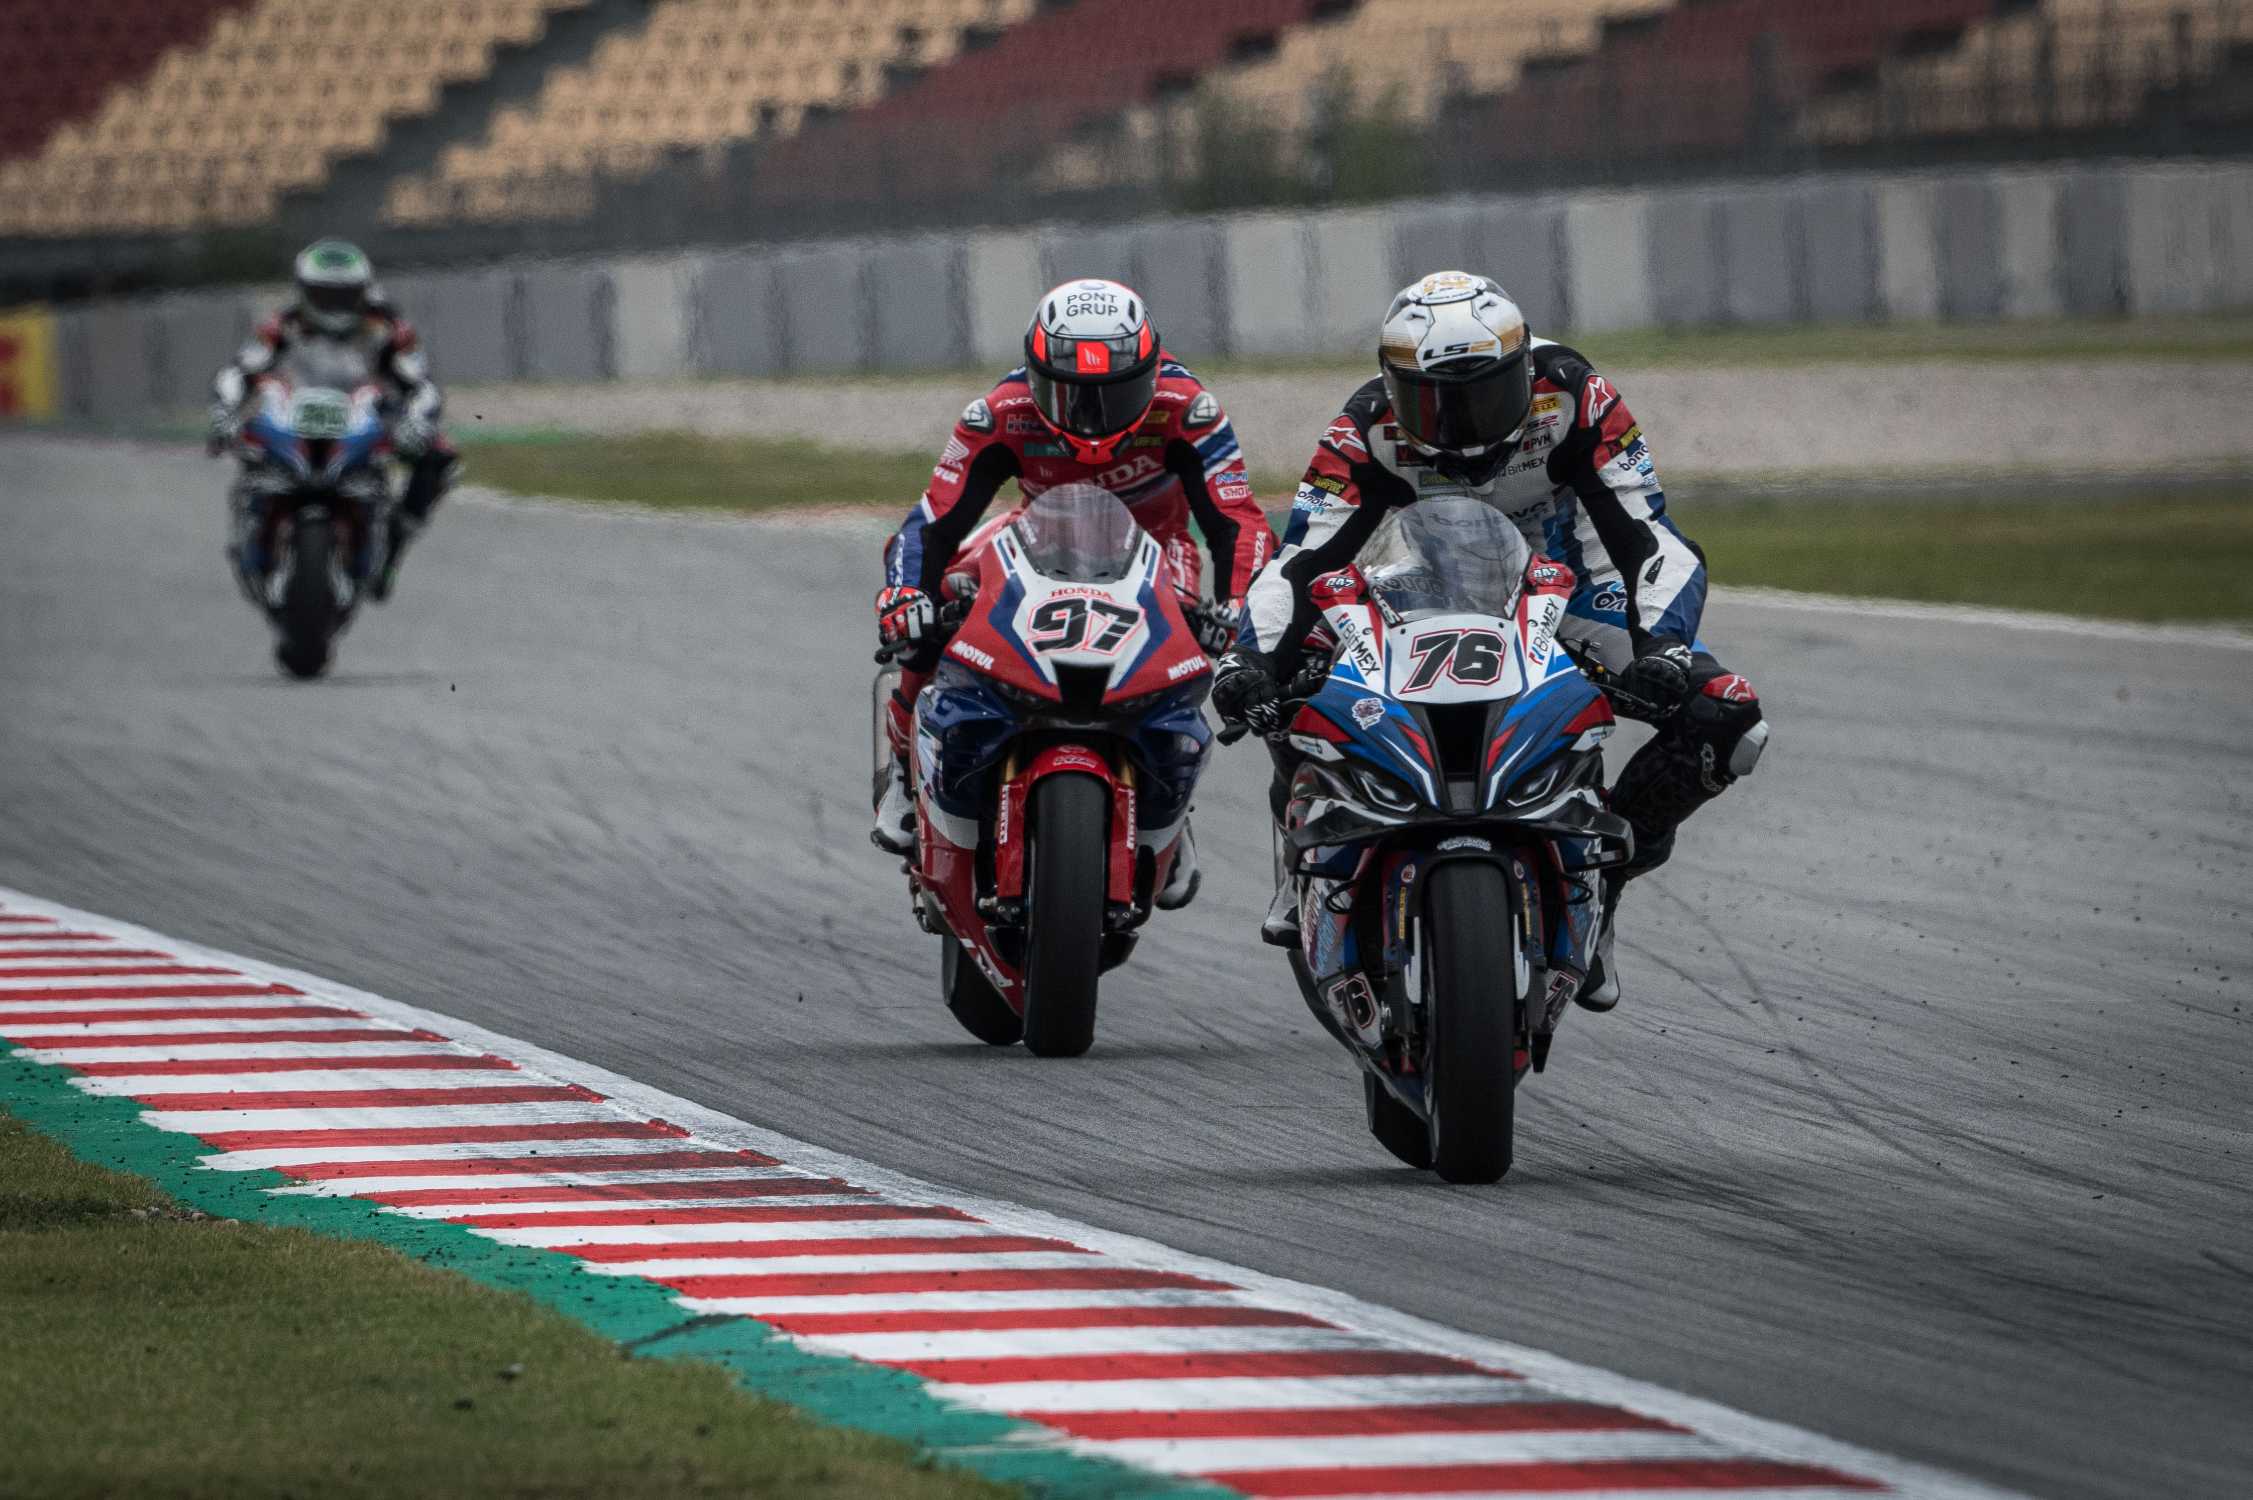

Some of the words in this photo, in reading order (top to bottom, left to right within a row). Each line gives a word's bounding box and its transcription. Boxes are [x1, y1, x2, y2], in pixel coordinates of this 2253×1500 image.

[1066, 303, 1119, 317] GRUP
[1067, 292, 1118, 304] PONT
[1423, 339, 1496, 361] LS2
[1508, 456, 1546, 476] BitMEX
[1051, 588, 1116, 602] HONDA
[1025, 597, 1146, 658] 97
[1534, 598, 1560, 652] BitMEX
[951, 640, 996, 671] MOTUL
[1342, 622, 1381, 677] BitMEX
[1400, 628, 1507, 694] 76
[1168, 655, 1207, 681] MOTUL
